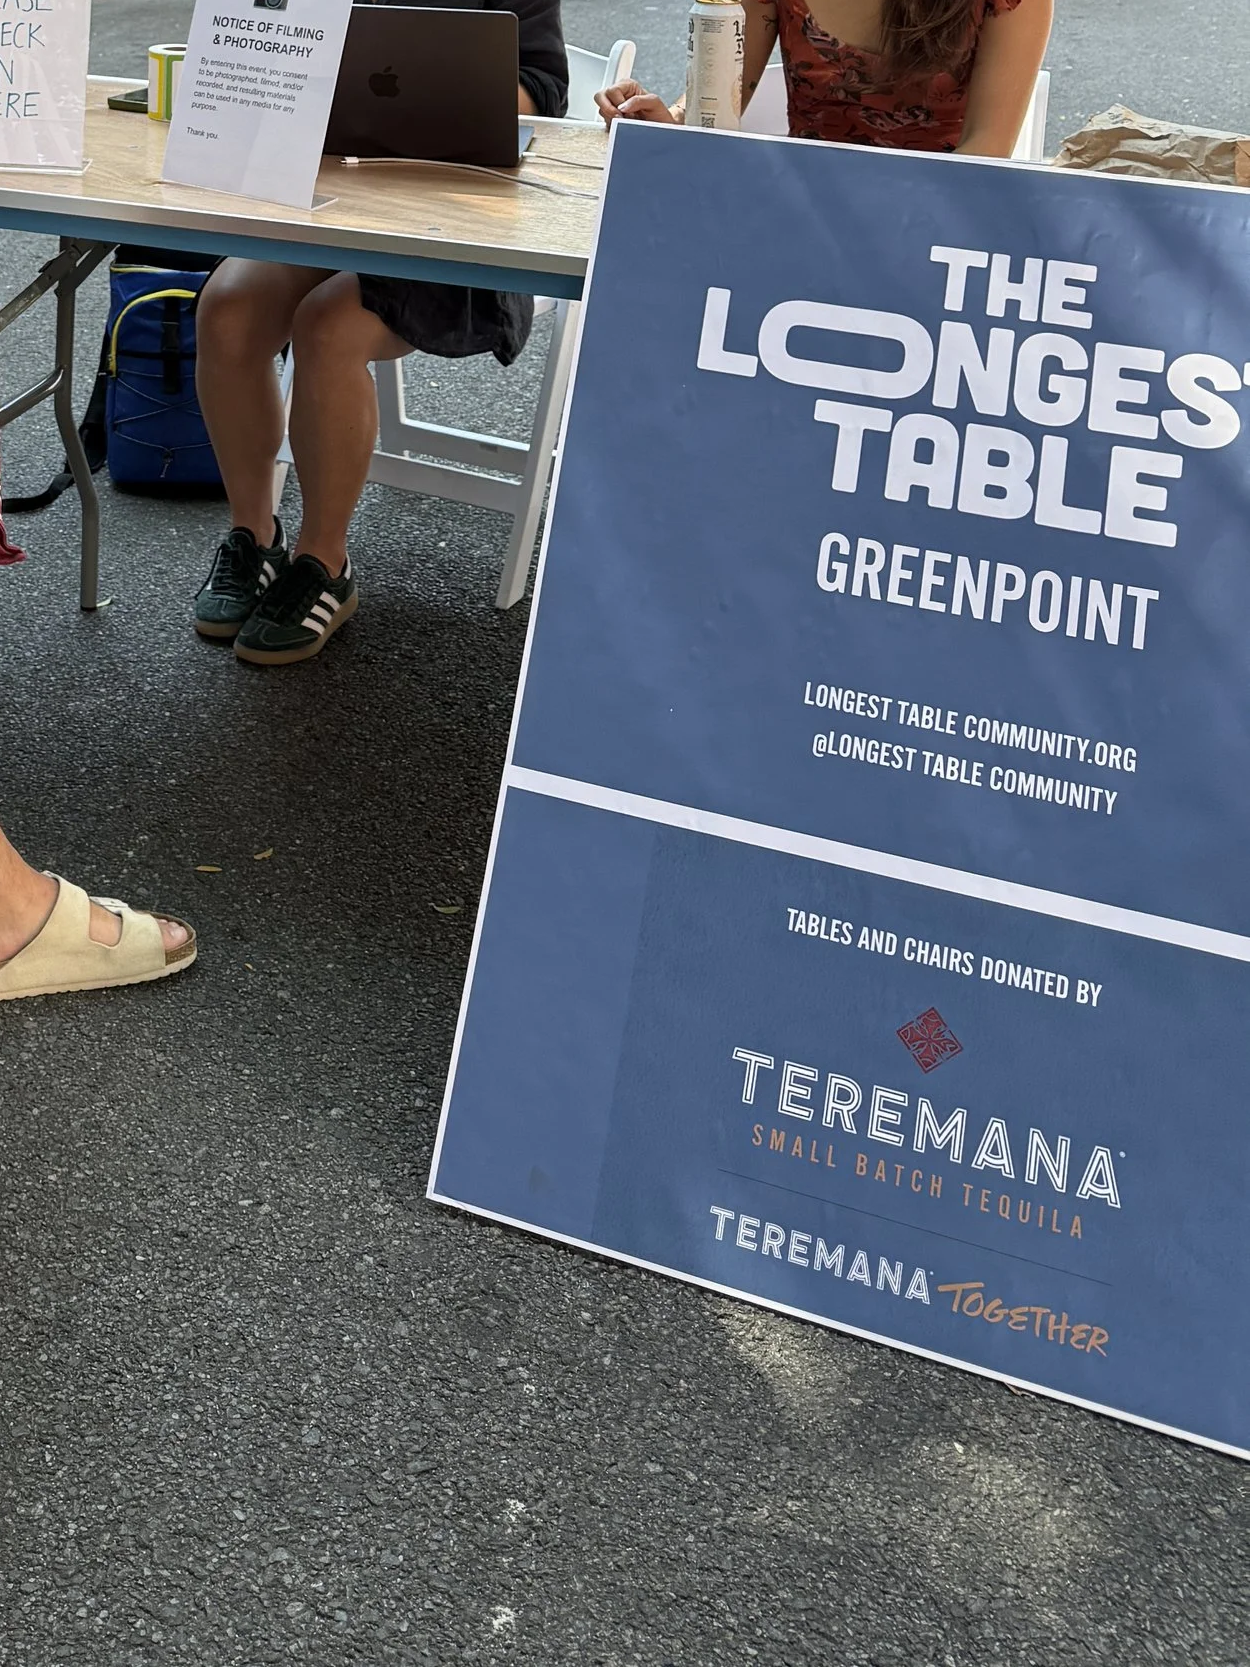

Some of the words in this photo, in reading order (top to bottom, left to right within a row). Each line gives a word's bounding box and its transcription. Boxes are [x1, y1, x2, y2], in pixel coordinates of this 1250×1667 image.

[200, 57, 209, 66] By
[210, 59, 235, 70] entering
[236, 62, 247, 71] this
[269, 68, 281, 76] you
[282, 71, 308, 80] consent
[212, 15, 254, 31] NOTICE
[257, 21, 274, 34] OF
[276, 24, 324, 41] FILMING
[213, 34, 221, 45] &
[224, 36, 314, 58] PHOTOGRAPHY
[191, 101, 218, 111] purpose.
[194, 90, 205, 98] can
[216, 94, 230, 102] used
[239, 98, 250, 107] any
[252, 100, 271, 109] media
[273, 103, 282, 111] for
[283, 106, 294, 114] any
[206, 69, 214, 77] be
[283, 82, 304, 91] and/or
[226, 84, 238, 92] and
[267, 91, 296, 102] materials
[187, 127, 205, 137] Thank
[206, 131, 219, 140] you.
[930, 245, 1098, 329] THE
[696, 286, 1250, 449] LONGES
[813, 399, 1184, 548] TABLE
[816, 532, 1160, 650] GREENPOINT
[804, 681, 892, 721] LONGEST
[897, 700, 959, 735] TABLE
[963, 714, 1138, 773] COMMUNITY.ORG
[812, 731, 917, 772] @LONGEST
[921, 750, 984, 787] TABLE
[989, 766, 1118, 816] COMMUNITY
[787, 907, 854, 945] TABLES
[857, 926, 897, 956] AND
[903, 937, 975, 976] CHAIRS
[980, 956, 1069, 1000] DONATED
[1075, 979, 1102, 1007] BY
[732, 1046, 1122, 1210] TEREMANA
[752, 1123, 837, 1168] SMALL
[856, 1153, 943, 1199] BATCH
[962, 1182, 1084, 1240] TEQUILA
[709, 1205, 931, 1305] TEREMANA
[937, 1282, 1110, 1357] TOGETHER
